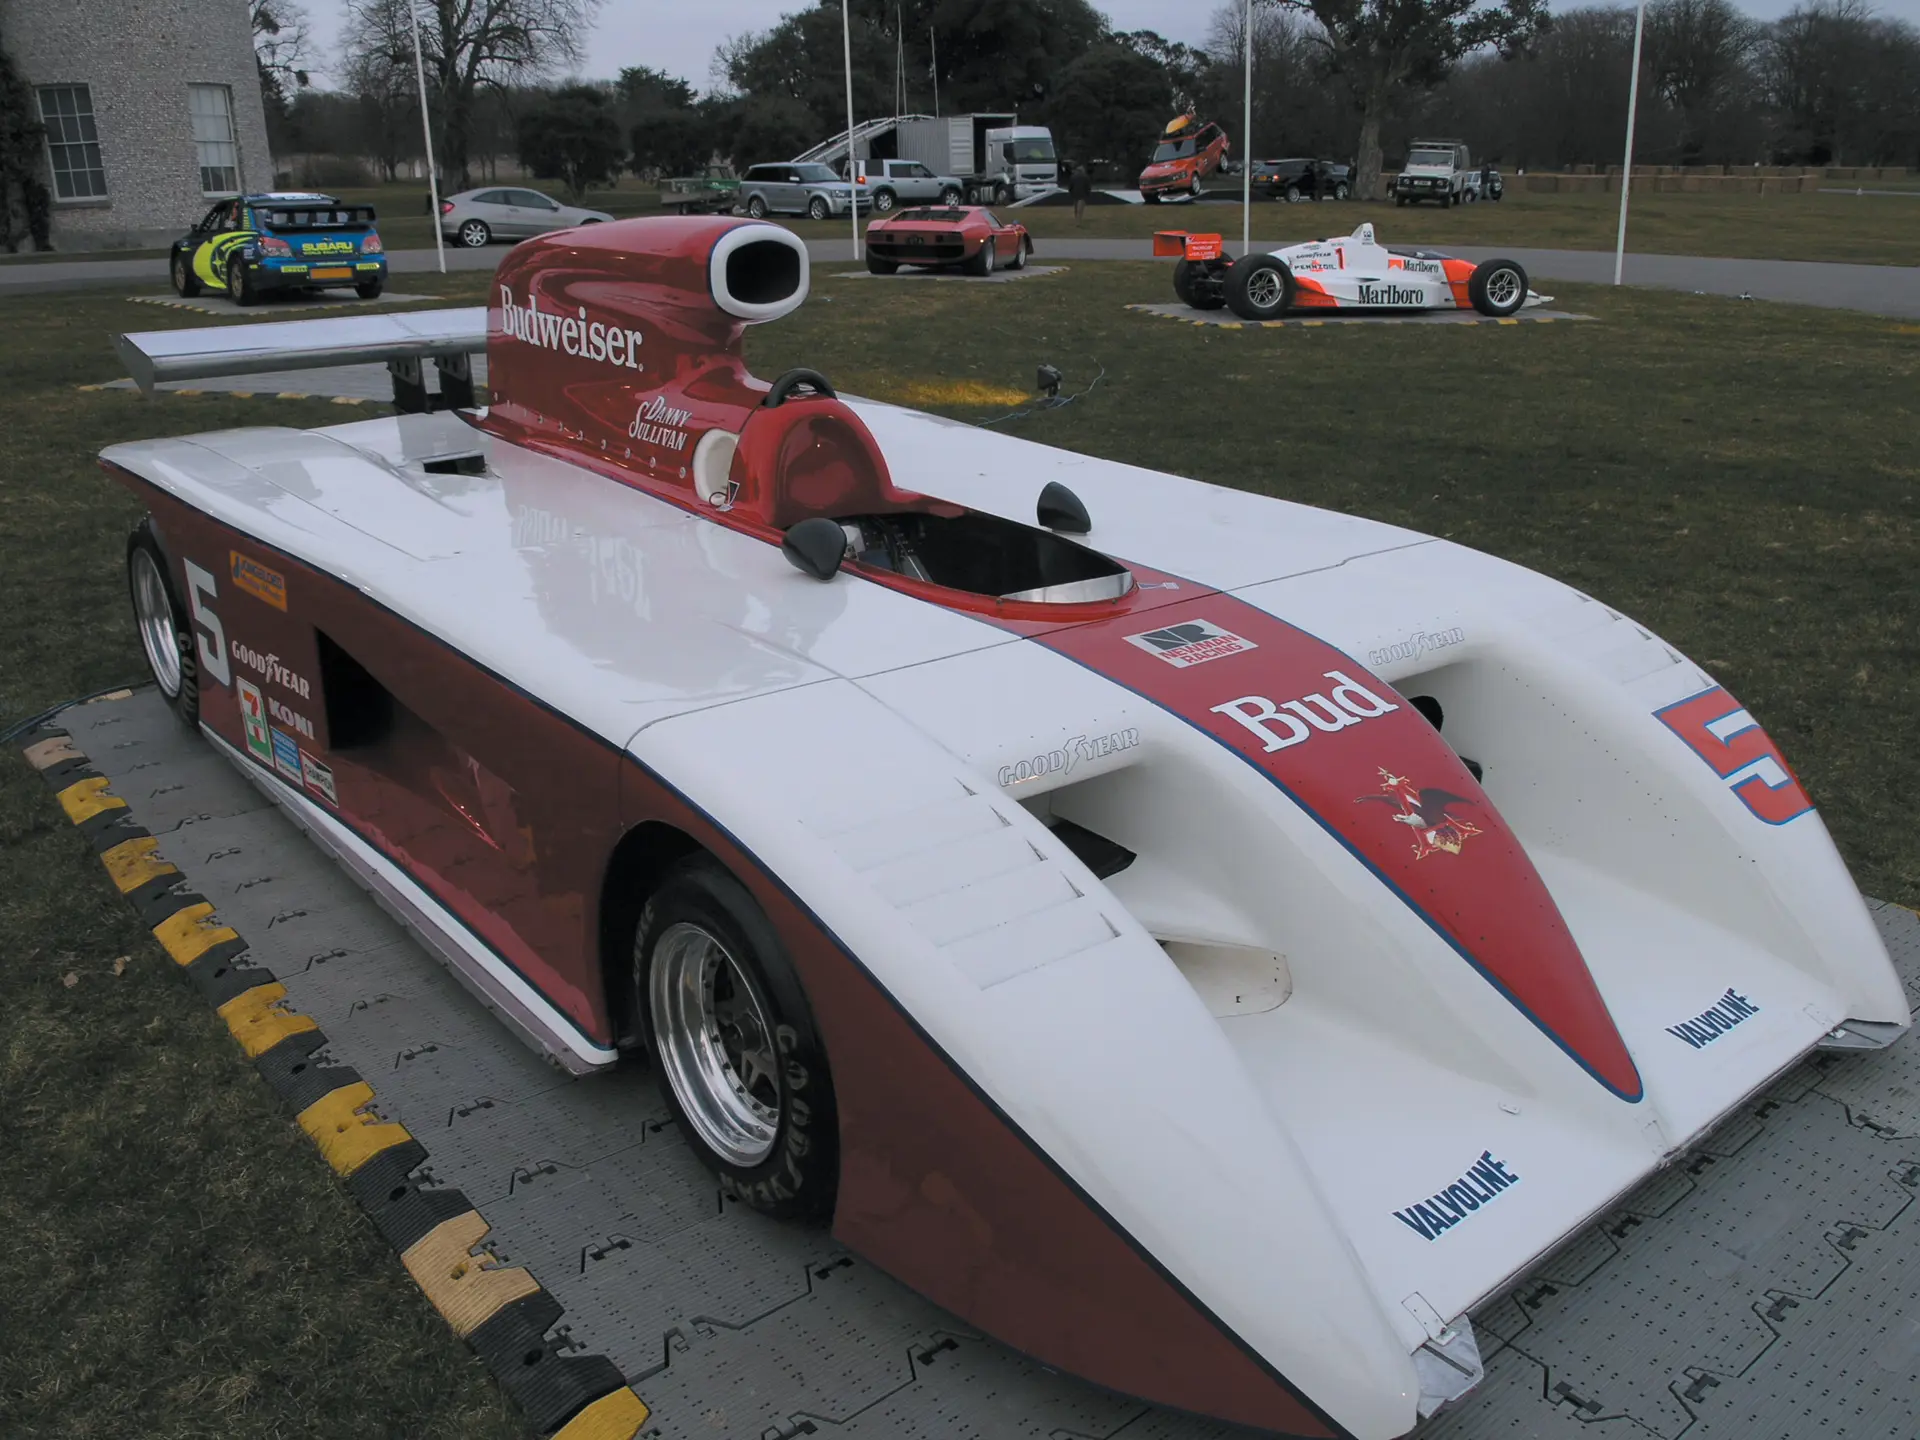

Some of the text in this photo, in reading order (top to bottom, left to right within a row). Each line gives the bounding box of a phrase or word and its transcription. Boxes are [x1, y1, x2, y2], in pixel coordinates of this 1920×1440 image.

[302, 241, 353, 251] SUBARU
[1294, 263, 1337, 271] PENNZOIL
[1335, 247, 1344, 270] 1
[1403, 259, 1439, 273] Marlboro
[1358, 284, 1424, 305] Marlboro
[500, 284, 643, 369] Budweiser
[628, 400, 688, 451] SULLIVAN
[645, 395, 693, 428] DANNY
[184, 557, 231, 687] 5
[1159, 635, 1240, 660] NEWMAN
[1179, 643, 1243, 664] RACING
[1369, 627, 1465, 666] GOODYEAR
[231, 640, 311, 700] GOODYEAR
[268, 697, 315, 741] KONI
[1209, 670, 1400, 753] Bud
[997, 727, 1140, 788] GOODYEAR
[1650, 684, 1817, 826] 5
[1665, 987, 1760, 1050] VALVOLINE
[1392, 1149, 1520, 1243] VALVOLINE
